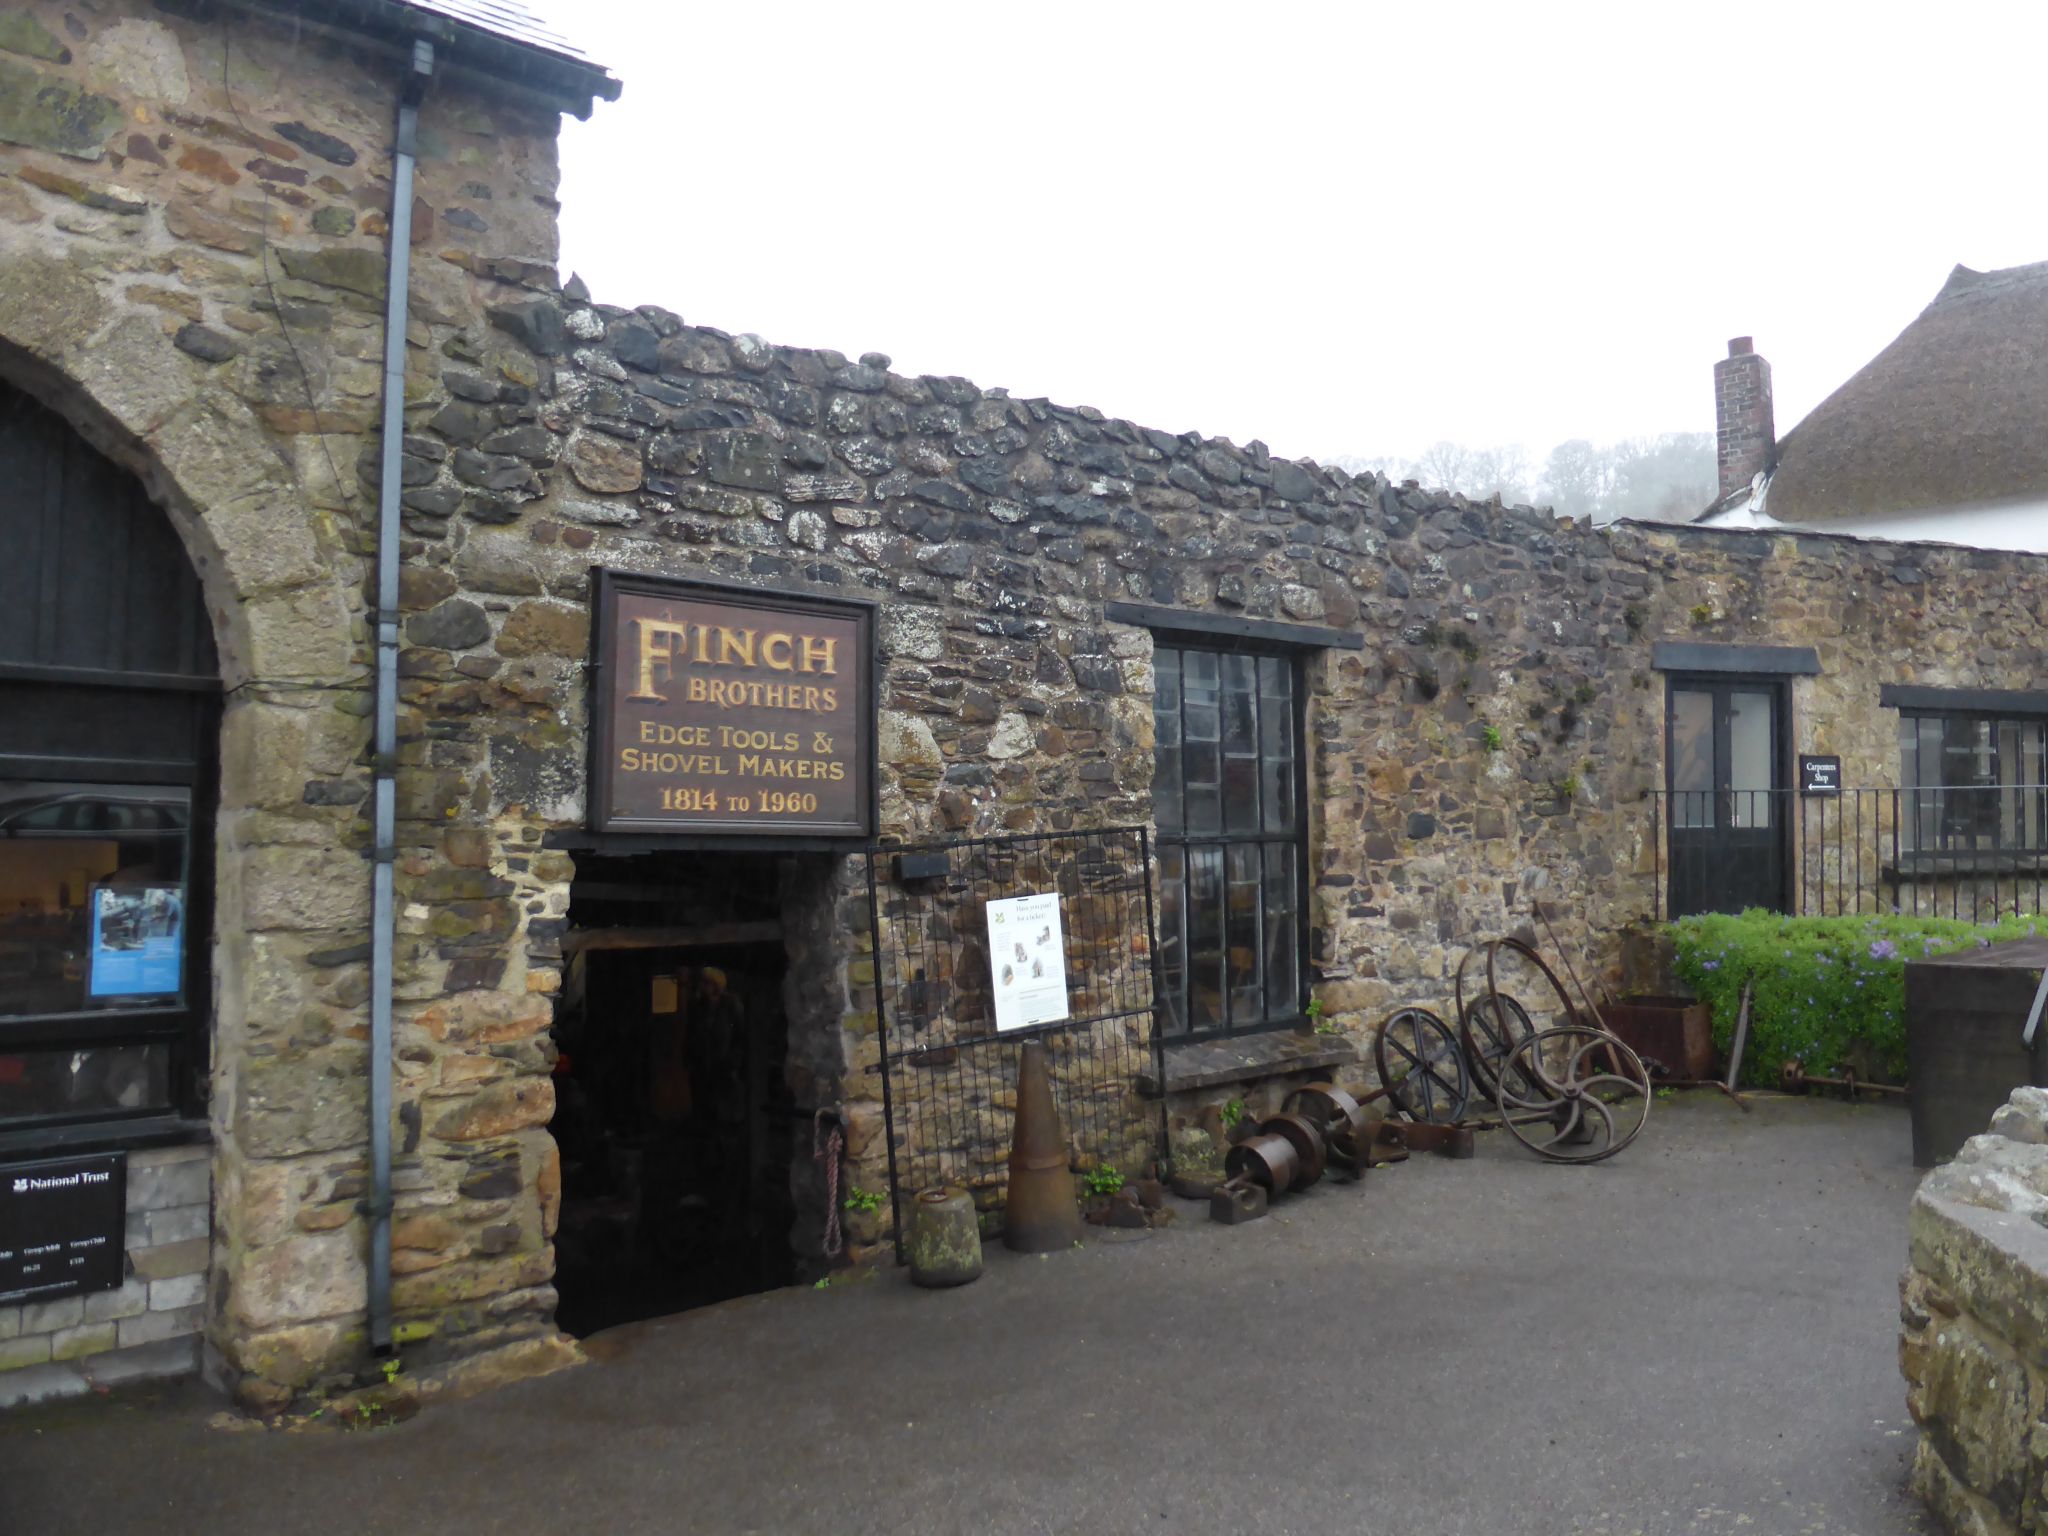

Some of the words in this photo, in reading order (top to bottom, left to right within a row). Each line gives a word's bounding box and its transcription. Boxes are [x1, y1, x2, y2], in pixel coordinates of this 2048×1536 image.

[626, 615, 838, 704] FINCH
[687, 678, 839, 713] BROTHERS
[640, 721, 711, 746] EDGE
[719, 726, 799, 752] TOOLS
[813, 732, 833, 754] &
[620, 748, 729, 775] SHOVEL
[739, 755, 846, 781] MAKERS
[1814, 772, 1829, 784] Shop
[661, 786, 717, 812] 1814
[727, 796, 750, 812] TO
[758, 789, 817, 814] 1960
[30, 1174, 79, 1190] National
[81, 1172, 110, 1184] Trust
